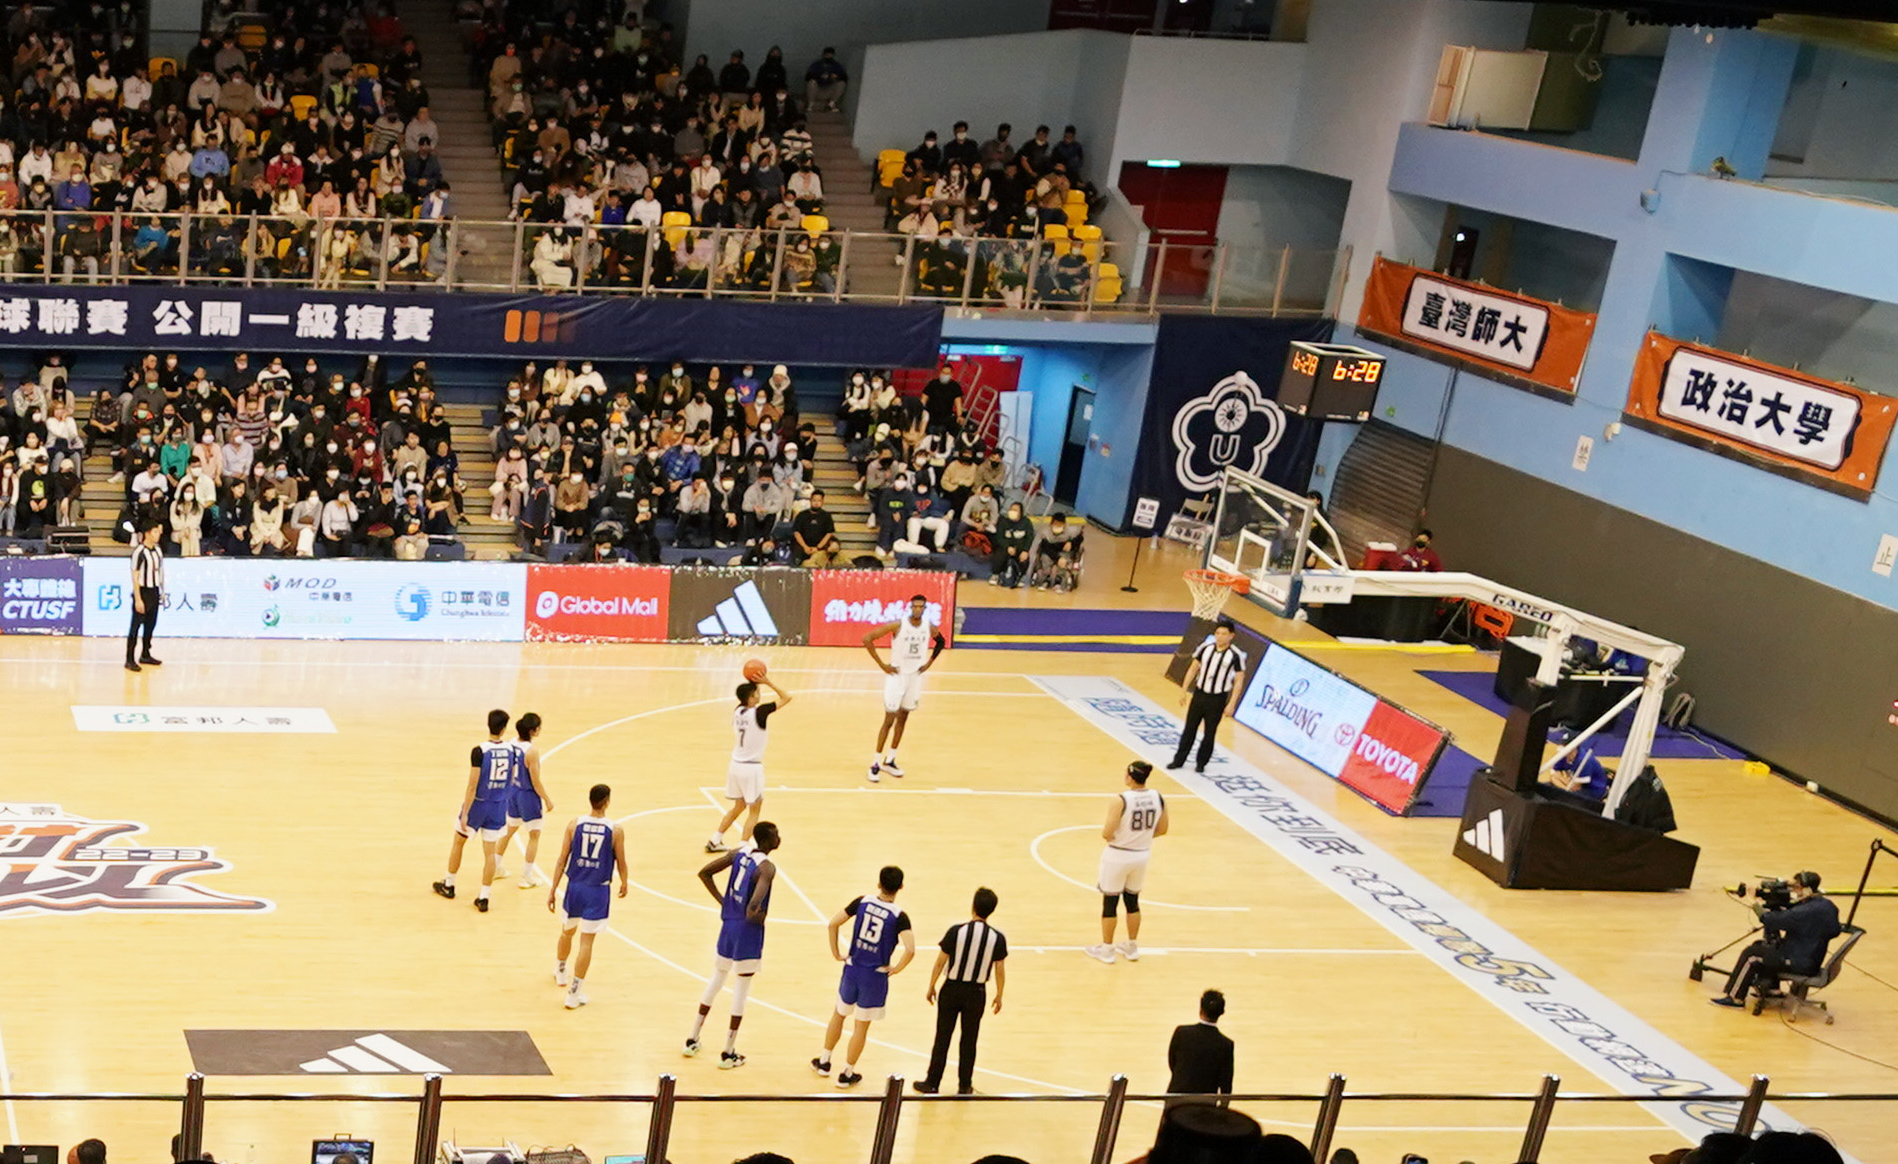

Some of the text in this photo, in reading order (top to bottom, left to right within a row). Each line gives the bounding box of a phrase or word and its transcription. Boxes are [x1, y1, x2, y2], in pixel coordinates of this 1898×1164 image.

[152, 300, 435, 342] 公開一級複賽
[1418, 291, 1530, 354] 臺灣師大
[1292, 351, 1320, 377] 6:28
[1332, 360, 1382, 383] 6:28
[1679, 368, 1833, 446] 政治大學
[284, 578, 338, 589] MOD
[2, 600, 76, 620] CTUSF
[441, 591, 510, 607] 中華電信
[560, 596, 659, 615] Global Mall
[160, 713, 293, 727] 富邦人壽
[1255, 684, 1323, 739] SPALDING
[489, 758, 510, 781] 12
[1355, 733, 1419, 785] TOYOTA
[1131, 809, 1157, 832] 80
[580, 834, 606, 859] 17
[859, 912, 886, 944] 13
